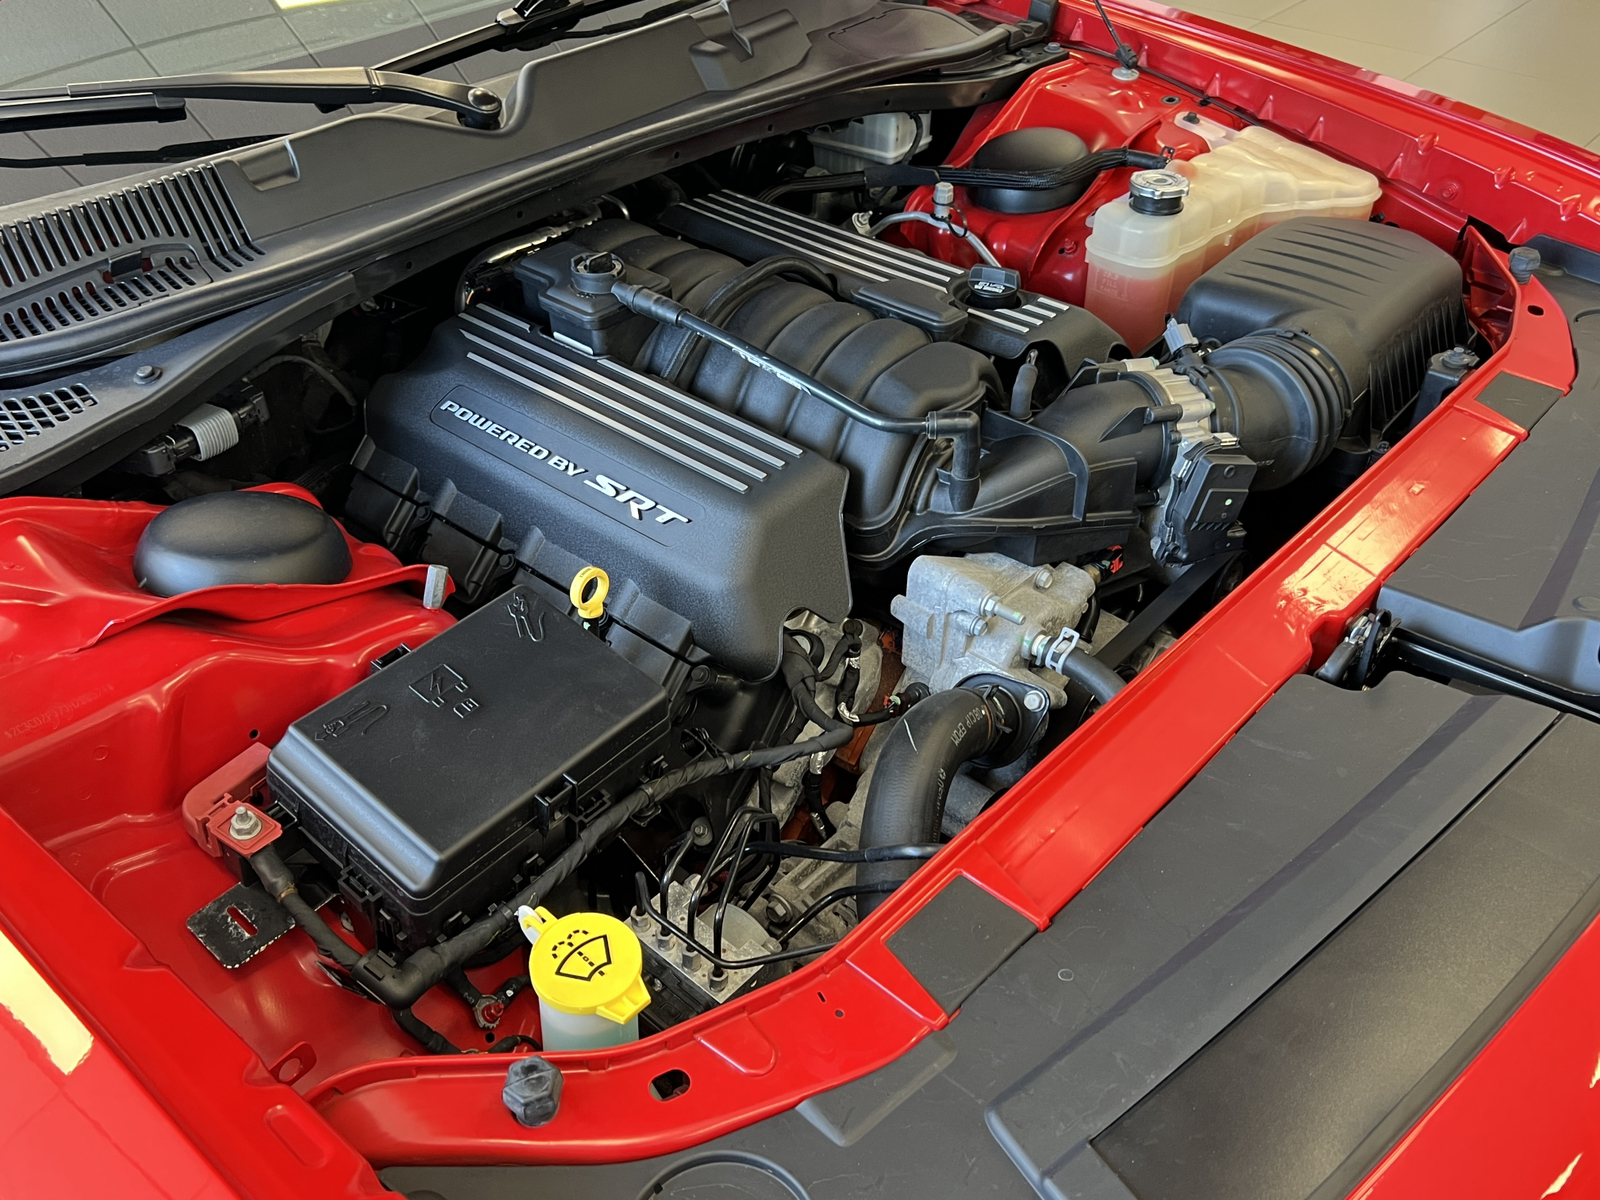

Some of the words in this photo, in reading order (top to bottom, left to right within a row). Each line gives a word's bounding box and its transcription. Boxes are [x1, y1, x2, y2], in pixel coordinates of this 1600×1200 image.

[440, 400, 551, 461] POWERED
[547, 455, 587, 477] BY
[583, 474, 692, 525] SRT
